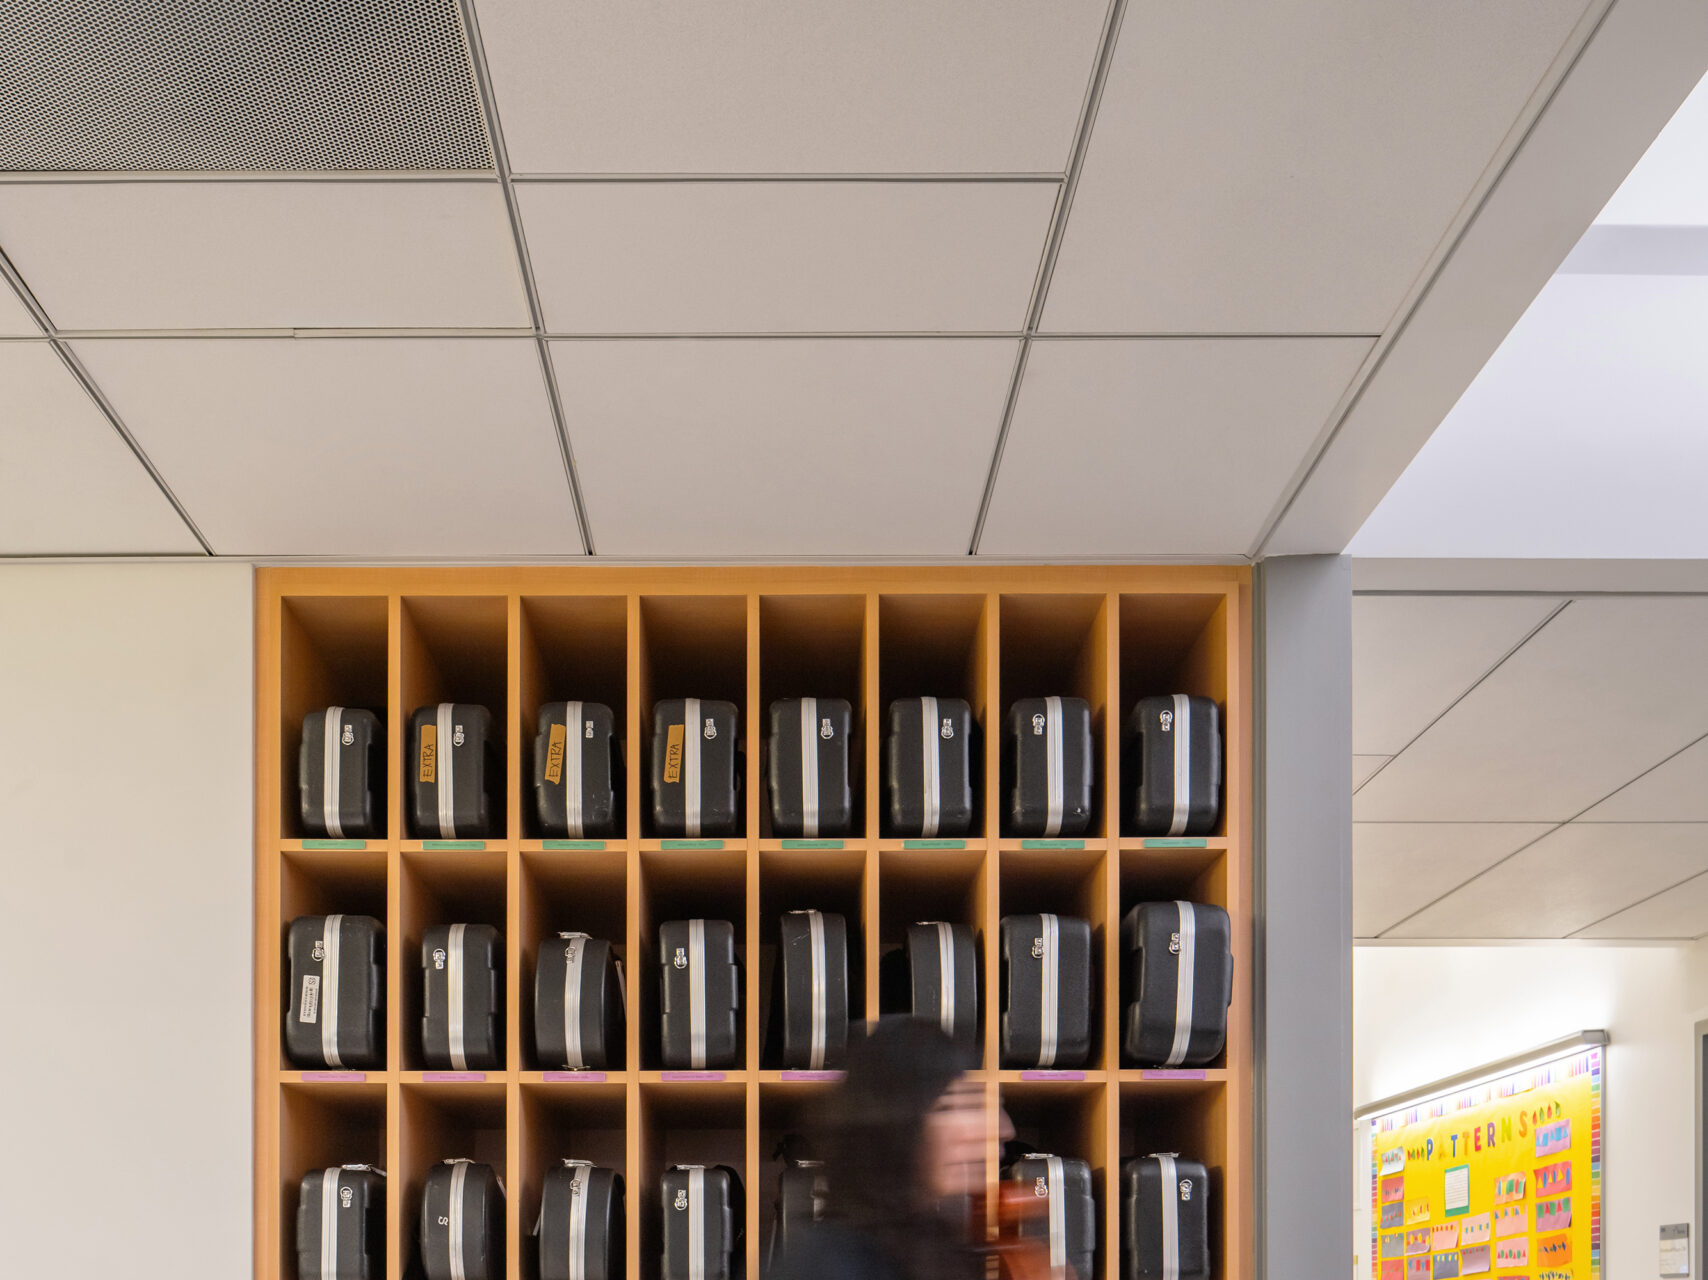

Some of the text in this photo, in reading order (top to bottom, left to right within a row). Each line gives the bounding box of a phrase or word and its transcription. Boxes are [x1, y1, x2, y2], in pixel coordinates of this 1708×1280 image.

[423, 743, 434, 778] EXTRA
[548, 741, 562, 778] EXTRA
[668, 743, 680, 779] EXTRA
[1426, 1110, 1528, 1161] PATTERNS
